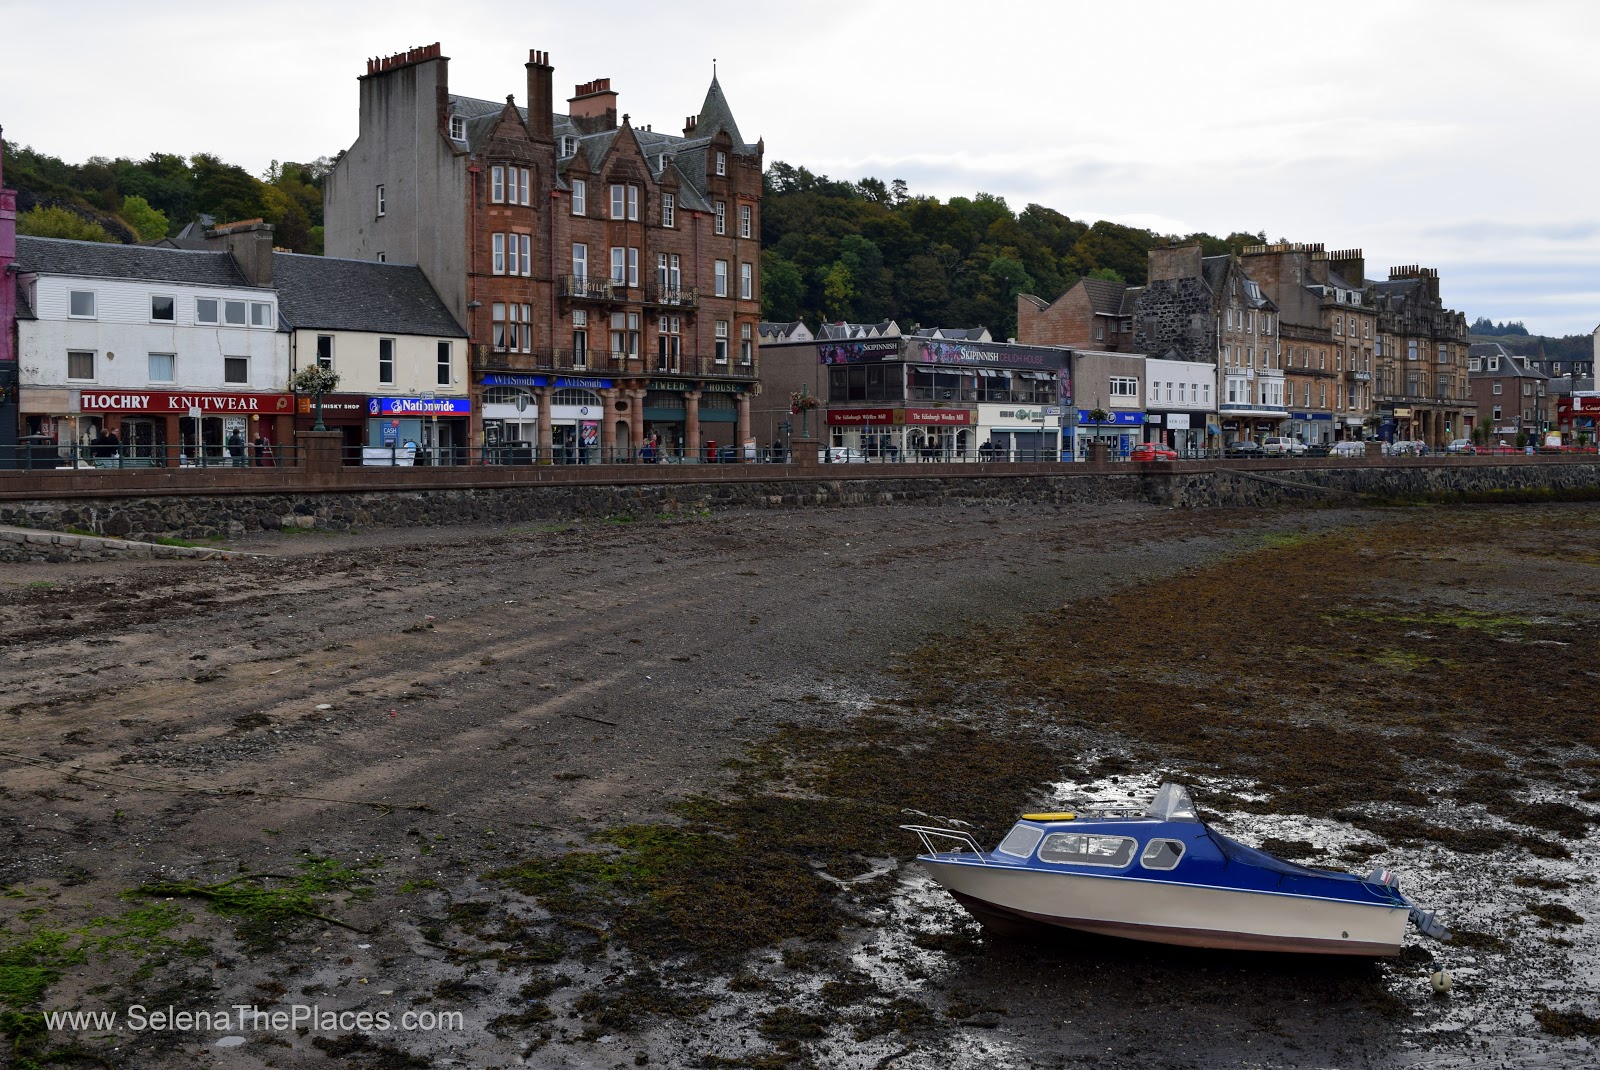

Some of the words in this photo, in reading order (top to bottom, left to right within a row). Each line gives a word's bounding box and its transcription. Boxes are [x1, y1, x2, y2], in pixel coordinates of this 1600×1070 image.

[960, 347, 999, 361] SKIPINNISH
[1023, 354, 1044, 365] HOUSE
[493, 375, 535, 386] WHSmith
[563, 378, 602, 388] WHSmith
[654, 382, 685, 390] TWEED
[708, 383, 737, 392] HOUSE
[81, 394, 150, 409] TLOCHRY
[168, 396, 258, 409] KNITWEAR
[383, 427, 397, 435] CASH
